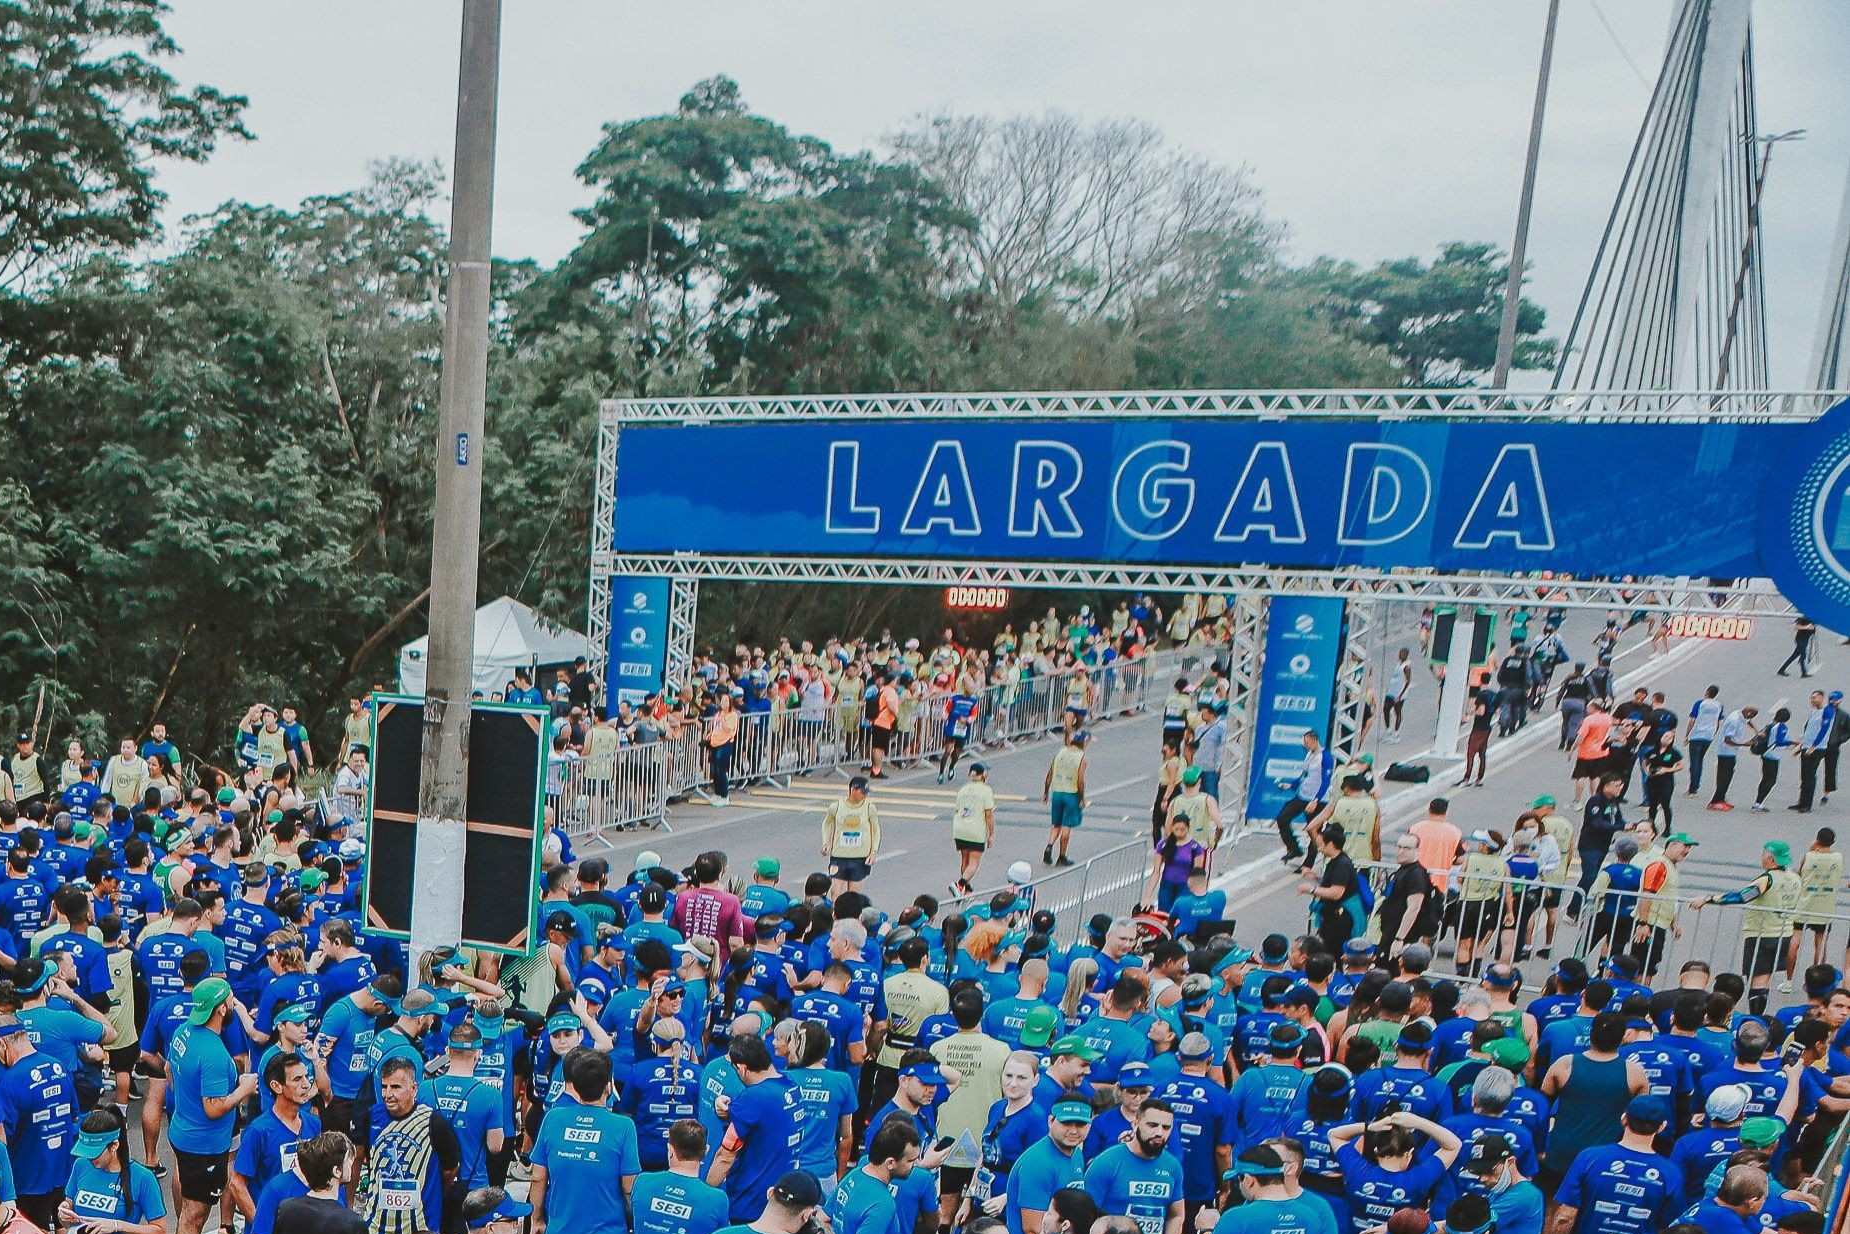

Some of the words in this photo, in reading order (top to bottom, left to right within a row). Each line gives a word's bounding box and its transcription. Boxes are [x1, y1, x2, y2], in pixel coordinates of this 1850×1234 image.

[825, 440, 1555, 551] LARGADA
[43, 1085, 61, 1096] SESI
[568, 1130, 598, 1142] SESI
[1134, 1183, 1168, 1196] SESI
[78, 1193, 115, 1210] SESI
[386, 1194, 412, 1207] 862
[654, 1201, 690, 1217] SESI
